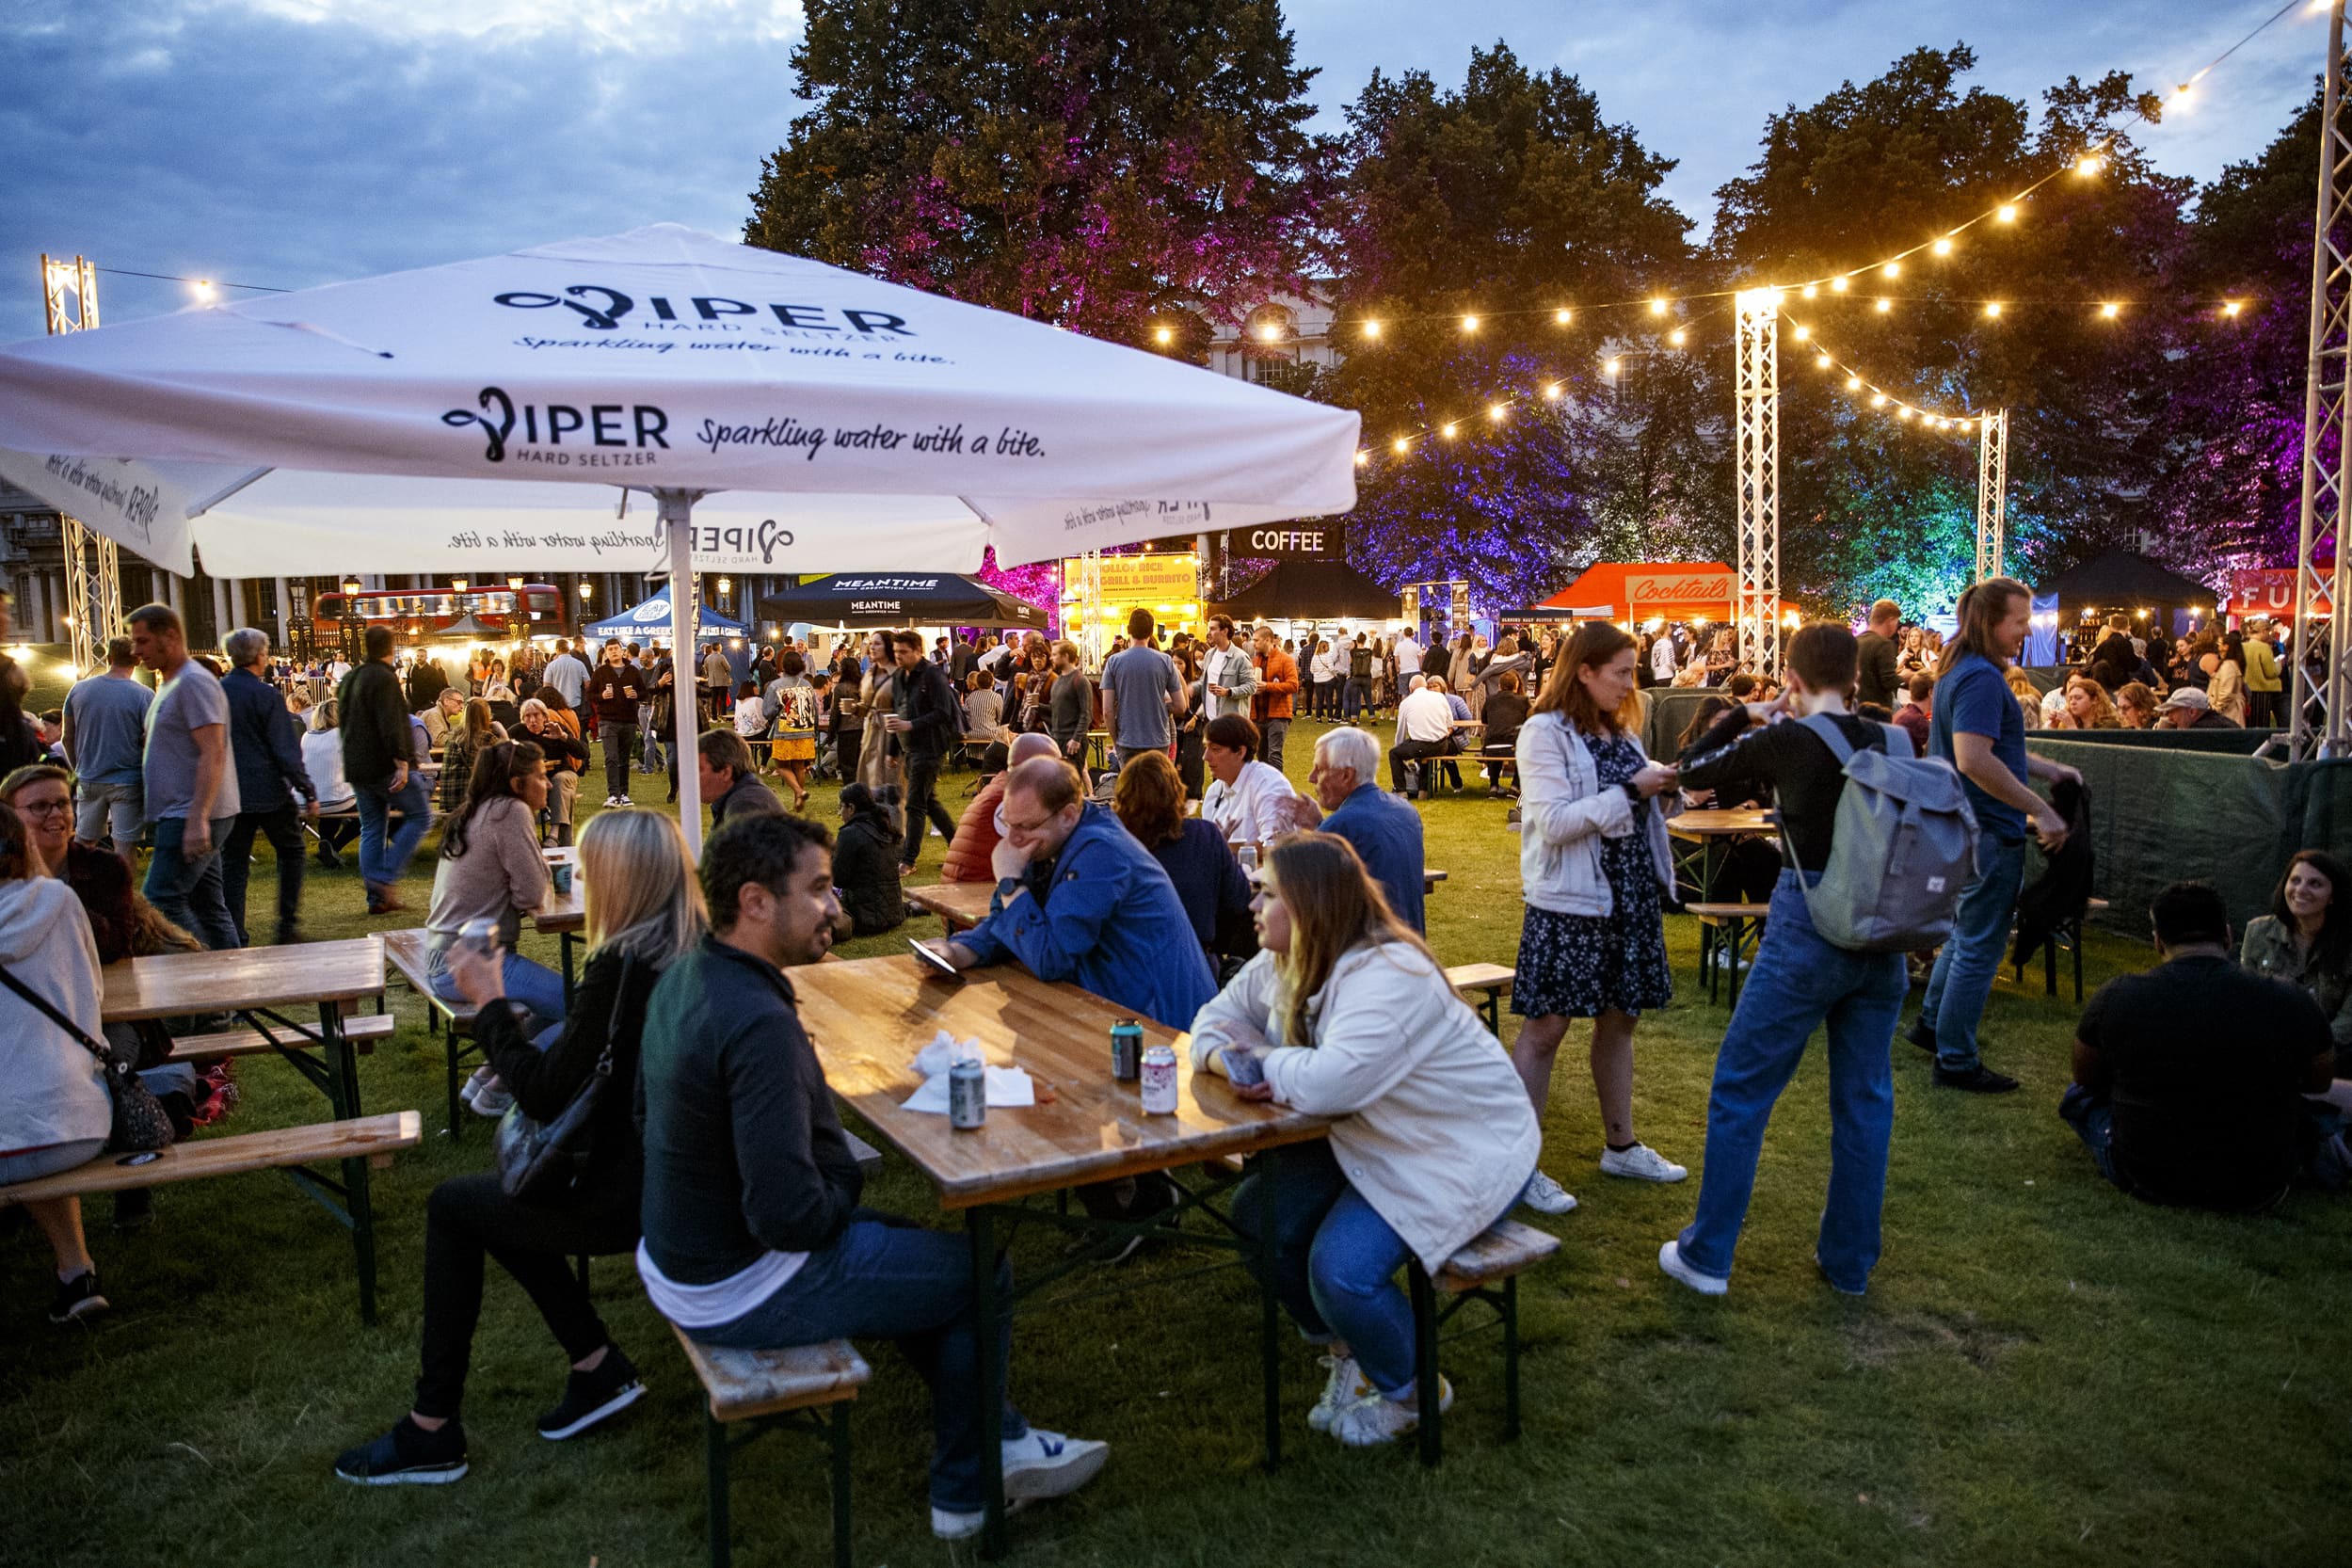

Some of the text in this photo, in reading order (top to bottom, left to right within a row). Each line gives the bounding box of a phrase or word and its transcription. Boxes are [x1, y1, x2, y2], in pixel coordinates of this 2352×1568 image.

[494, 285, 916, 336] VIPER
[644, 321, 742, 330] HARD
[690, 340, 779, 352] water
[790, 345, 850, 358] with
[863, 352, 882, 361] a
[441, 387, 1047, 462] VIPER Sparkling water with a bite.
[518, 449, 657, 467] HARD SELTZER
[1251, 530, 1324, 552] COFFEE
[1139, 562, 1163, 571] RICE
[835, 578, 939, 588] MEANTIME
[1132, 575, 1141, 584] &
[1143, 573, 1191, 584] BURRITO
[1634, 577, 1730, 600] Cocktails
[851, 600, 901, 610] MEANTIME
[598, 626, 614, 636] EAT
[614, 625, 634, 636] LIKE
[634, 625, 643, 635] A
